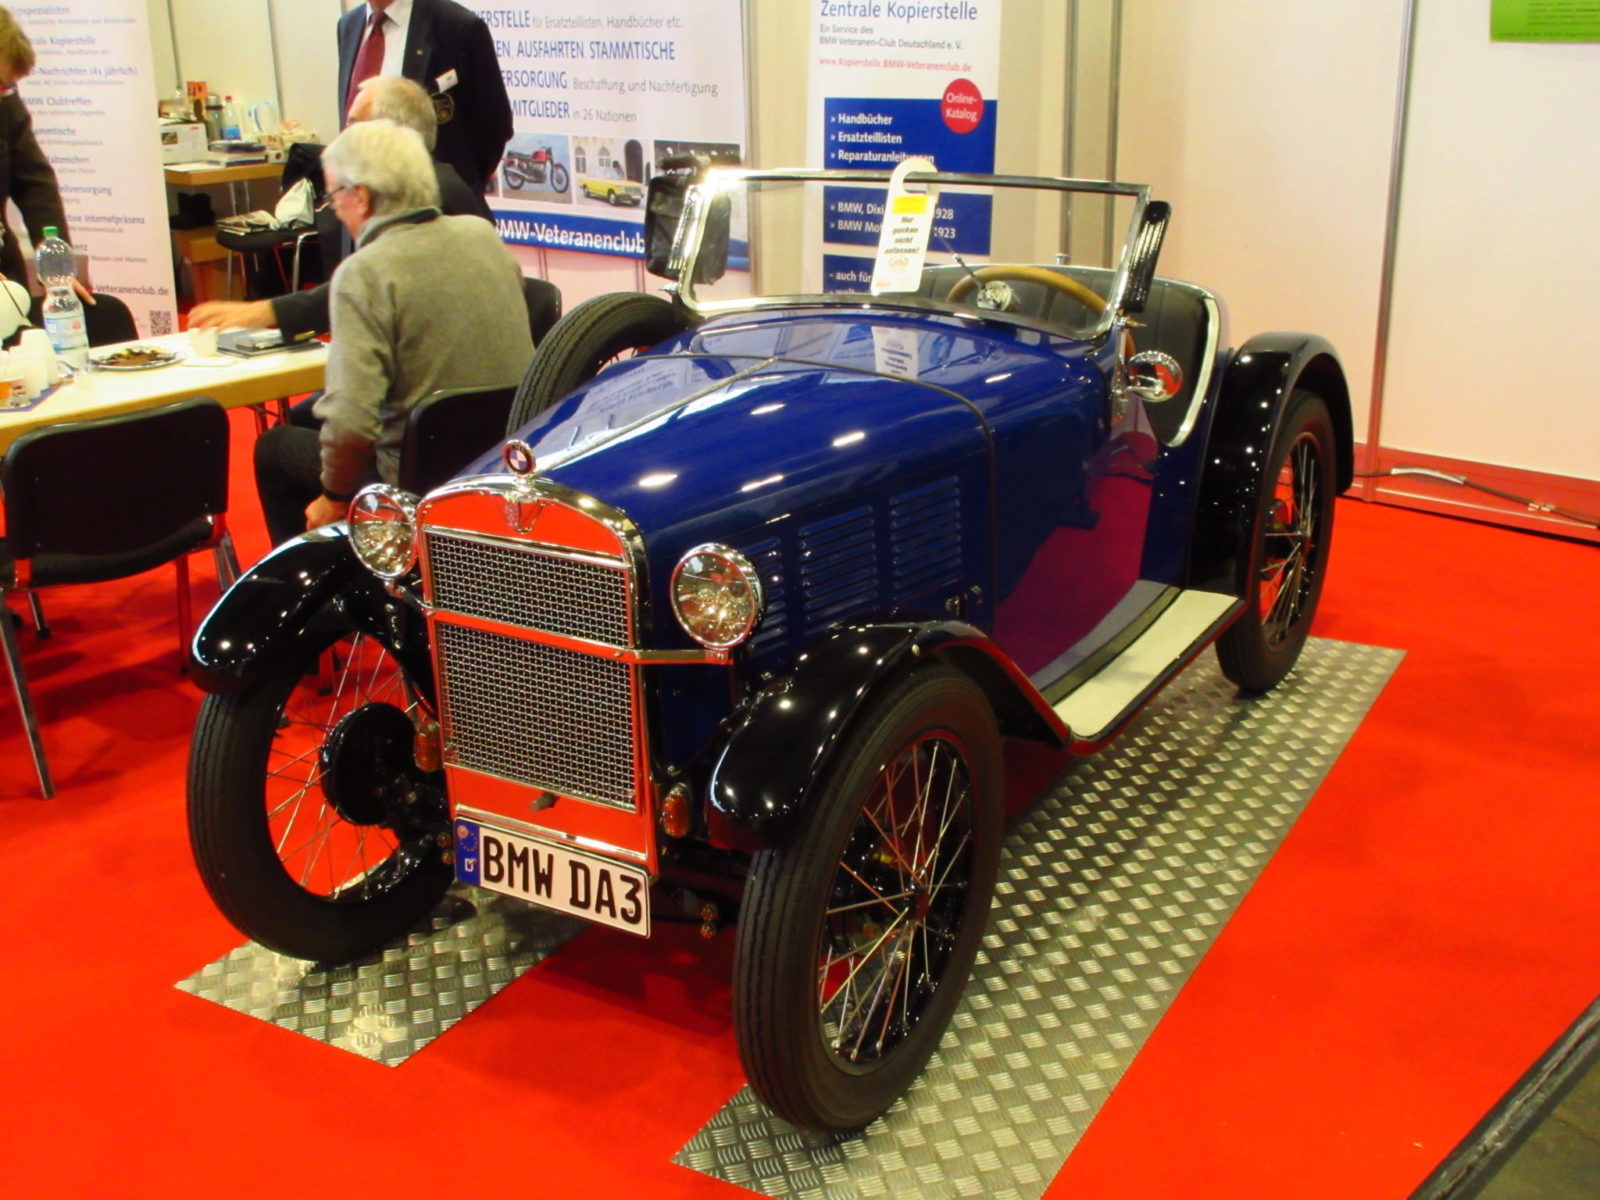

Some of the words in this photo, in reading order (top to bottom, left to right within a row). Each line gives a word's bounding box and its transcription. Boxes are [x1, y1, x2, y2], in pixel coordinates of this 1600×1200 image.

[820, 1, 881, 18] Zentrale
[887, 1, 979, 23] Kopierstelle
[477, 10, 530, 28] ERSTELLE
[607, 15, 664, 29] Handbücher
[666, 17, 683, 28] etc.
[832, 24, 858, 34] Service
[860, 25, 874, 34] des
[820, 36, 837, 45] BMW
[898, 39, 945, 49] Deutschland
[589, 41, 676, 60] STAMMTISCHE
[572, 78, 625, 94] Beschaffung
[627, 80, 646, 92] und
[648, 80, 719, 98] Nachfertigung
[946, 92, 978, 105] Online-
[583, 108, 594, 120] 26
[596, 109, 637, 122] Nationen
[838, 113, 893, 125] Handbücher
[946, 108, 978, 122] Katalog
[838, 131, 902, 144] Ersatzteillisten
[838, 201, 864, 215] BMW,
[866, 203, 885, 215] Dixi
[838, 219, 863, 231] BMW
[835, 269, 857, 282] auch
[859, 271, 872, 283] für
[483, 835, 554, 900] BMW
[568, 859, 642, 926] DA3
